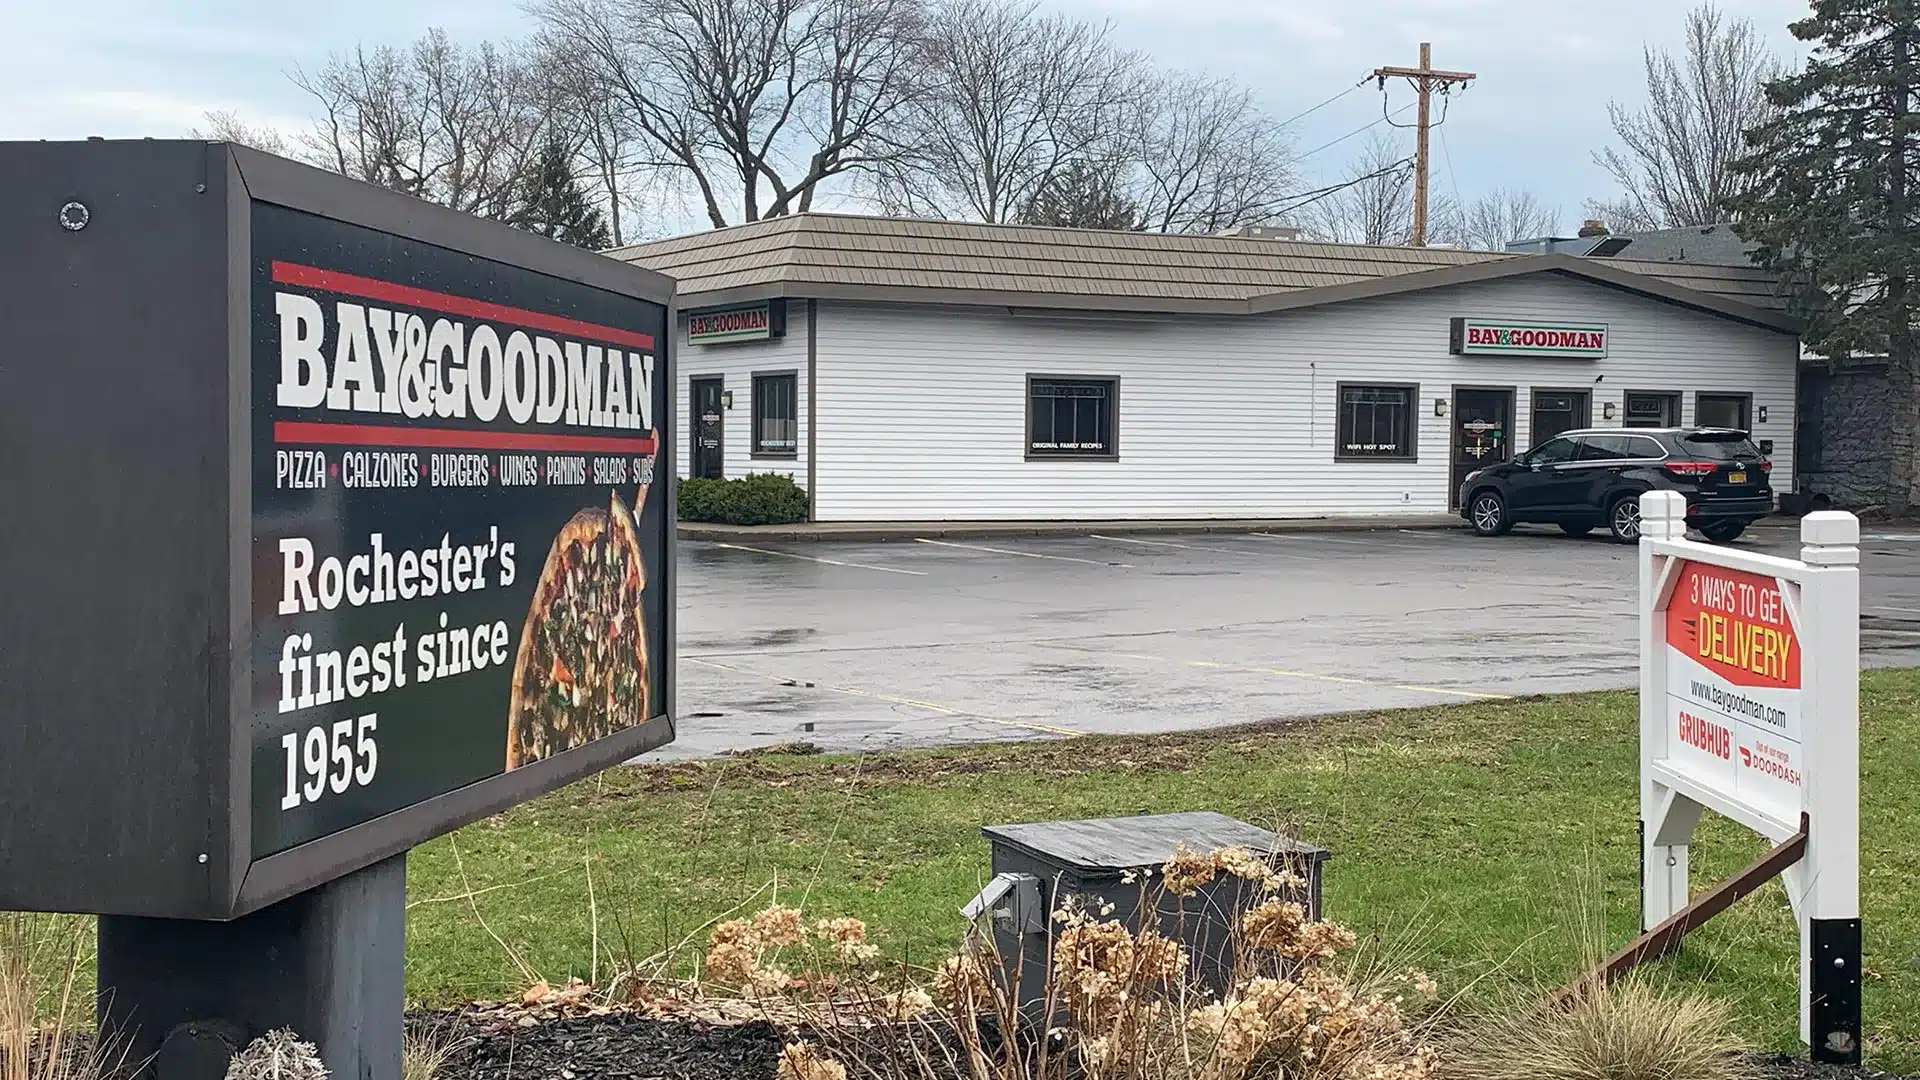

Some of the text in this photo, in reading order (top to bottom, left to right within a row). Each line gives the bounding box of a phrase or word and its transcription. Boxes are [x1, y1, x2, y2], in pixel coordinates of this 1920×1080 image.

[275, 292, 654, 430] BAY&GOODMAN
[1468, 328, 1604, 348] BAY&GOODMAN
[276, 450, 654, 489] PIZZA CALZONES BURGERS WINGS PANINIS SALADS SUBS
[278, 525, 516, 616] Rochester's
[1691, 573, 1785, 625] 3 WAYS TO GET
[278, 611, 509, 714] finest since
[1700, 611, 1792, 682] DELIVERY
[1690, 679, 1786, 728] www.baygoodman.com
[1678, 710, 1730, 760] GRUBHUB
[281, 712, 378, 811] 1955
[1753, 755, 1801, 787] DOORDASH
